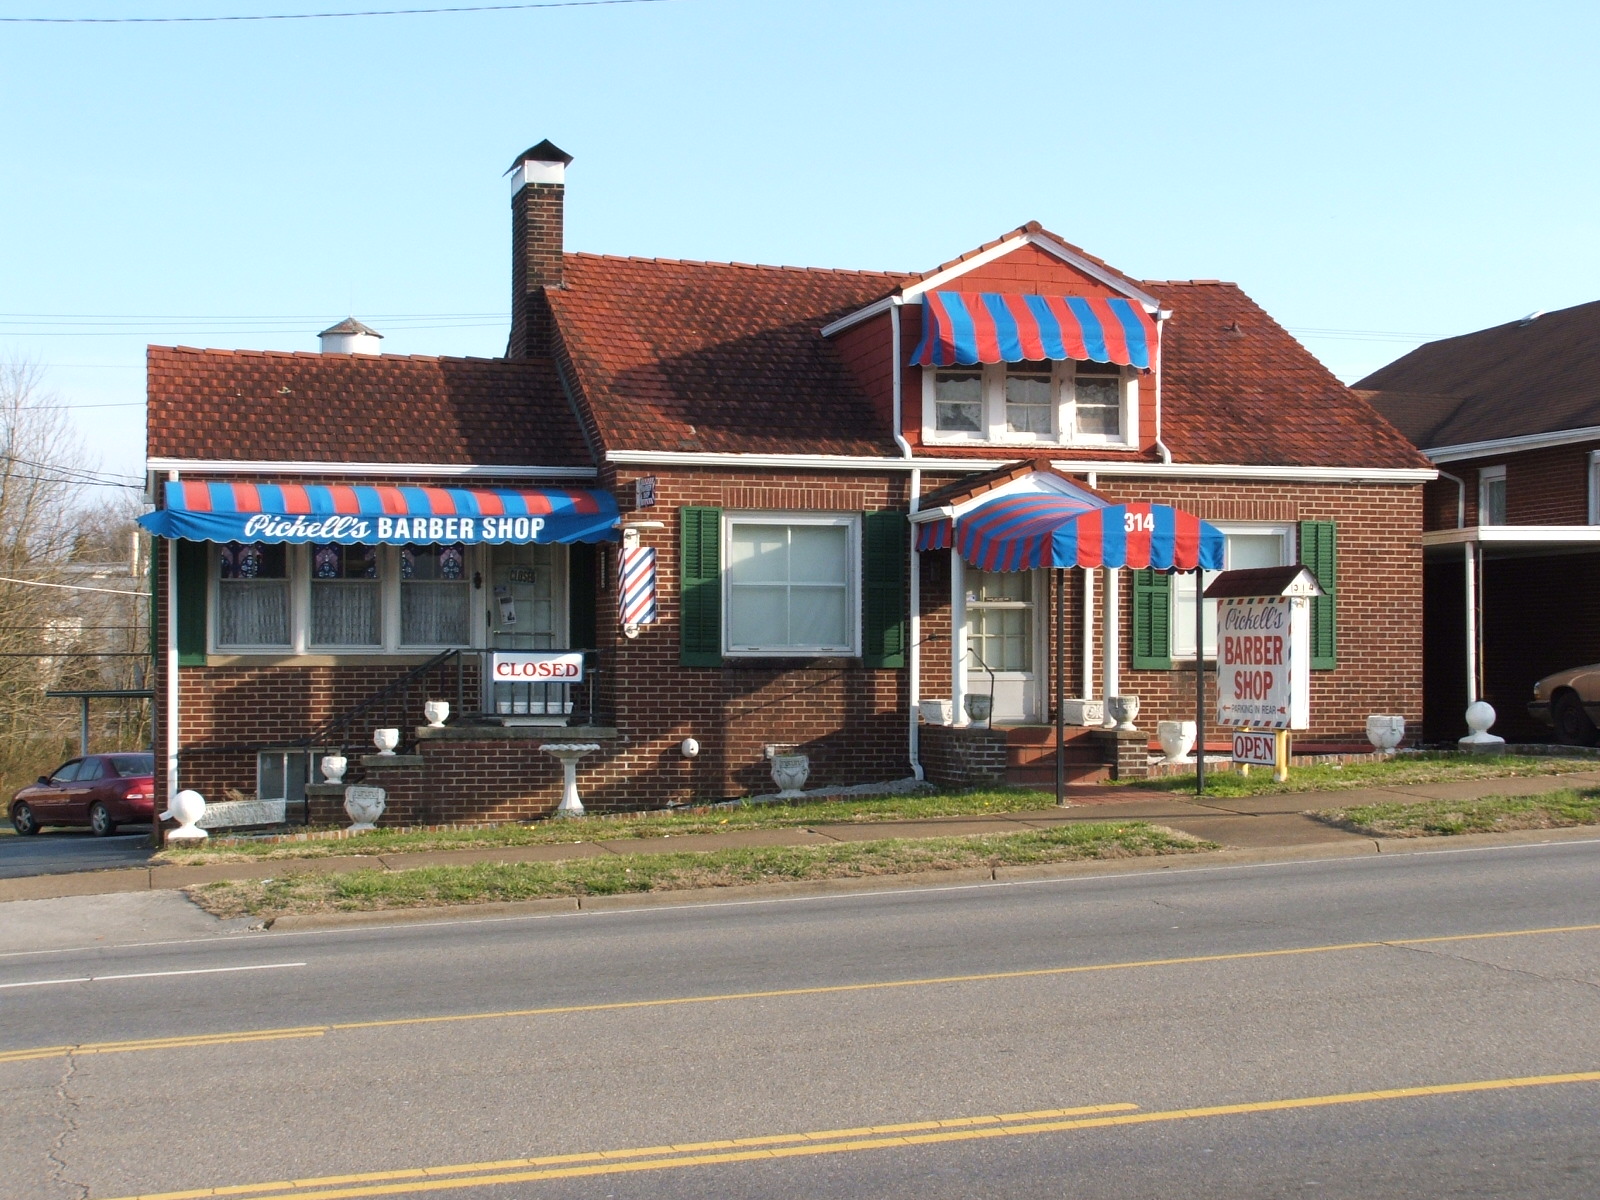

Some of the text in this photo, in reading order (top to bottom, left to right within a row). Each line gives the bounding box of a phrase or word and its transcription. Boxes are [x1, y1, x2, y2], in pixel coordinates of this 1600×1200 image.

[244, 514, 545, 539] Pickell's BARBER SHOP
[1124, 512, 1155, 532] 314
[1225, 606, 1284, 630] Pickell's
[1225, 636, 1283, 665] BARBER
[497, 662, 579, 677] CLOSED
[1234, 670, 1273, 700] SHOP
[1232, 704, 1276, 714] PARKING IN REAR
[1235, 736, 1273, 760] OPEN
